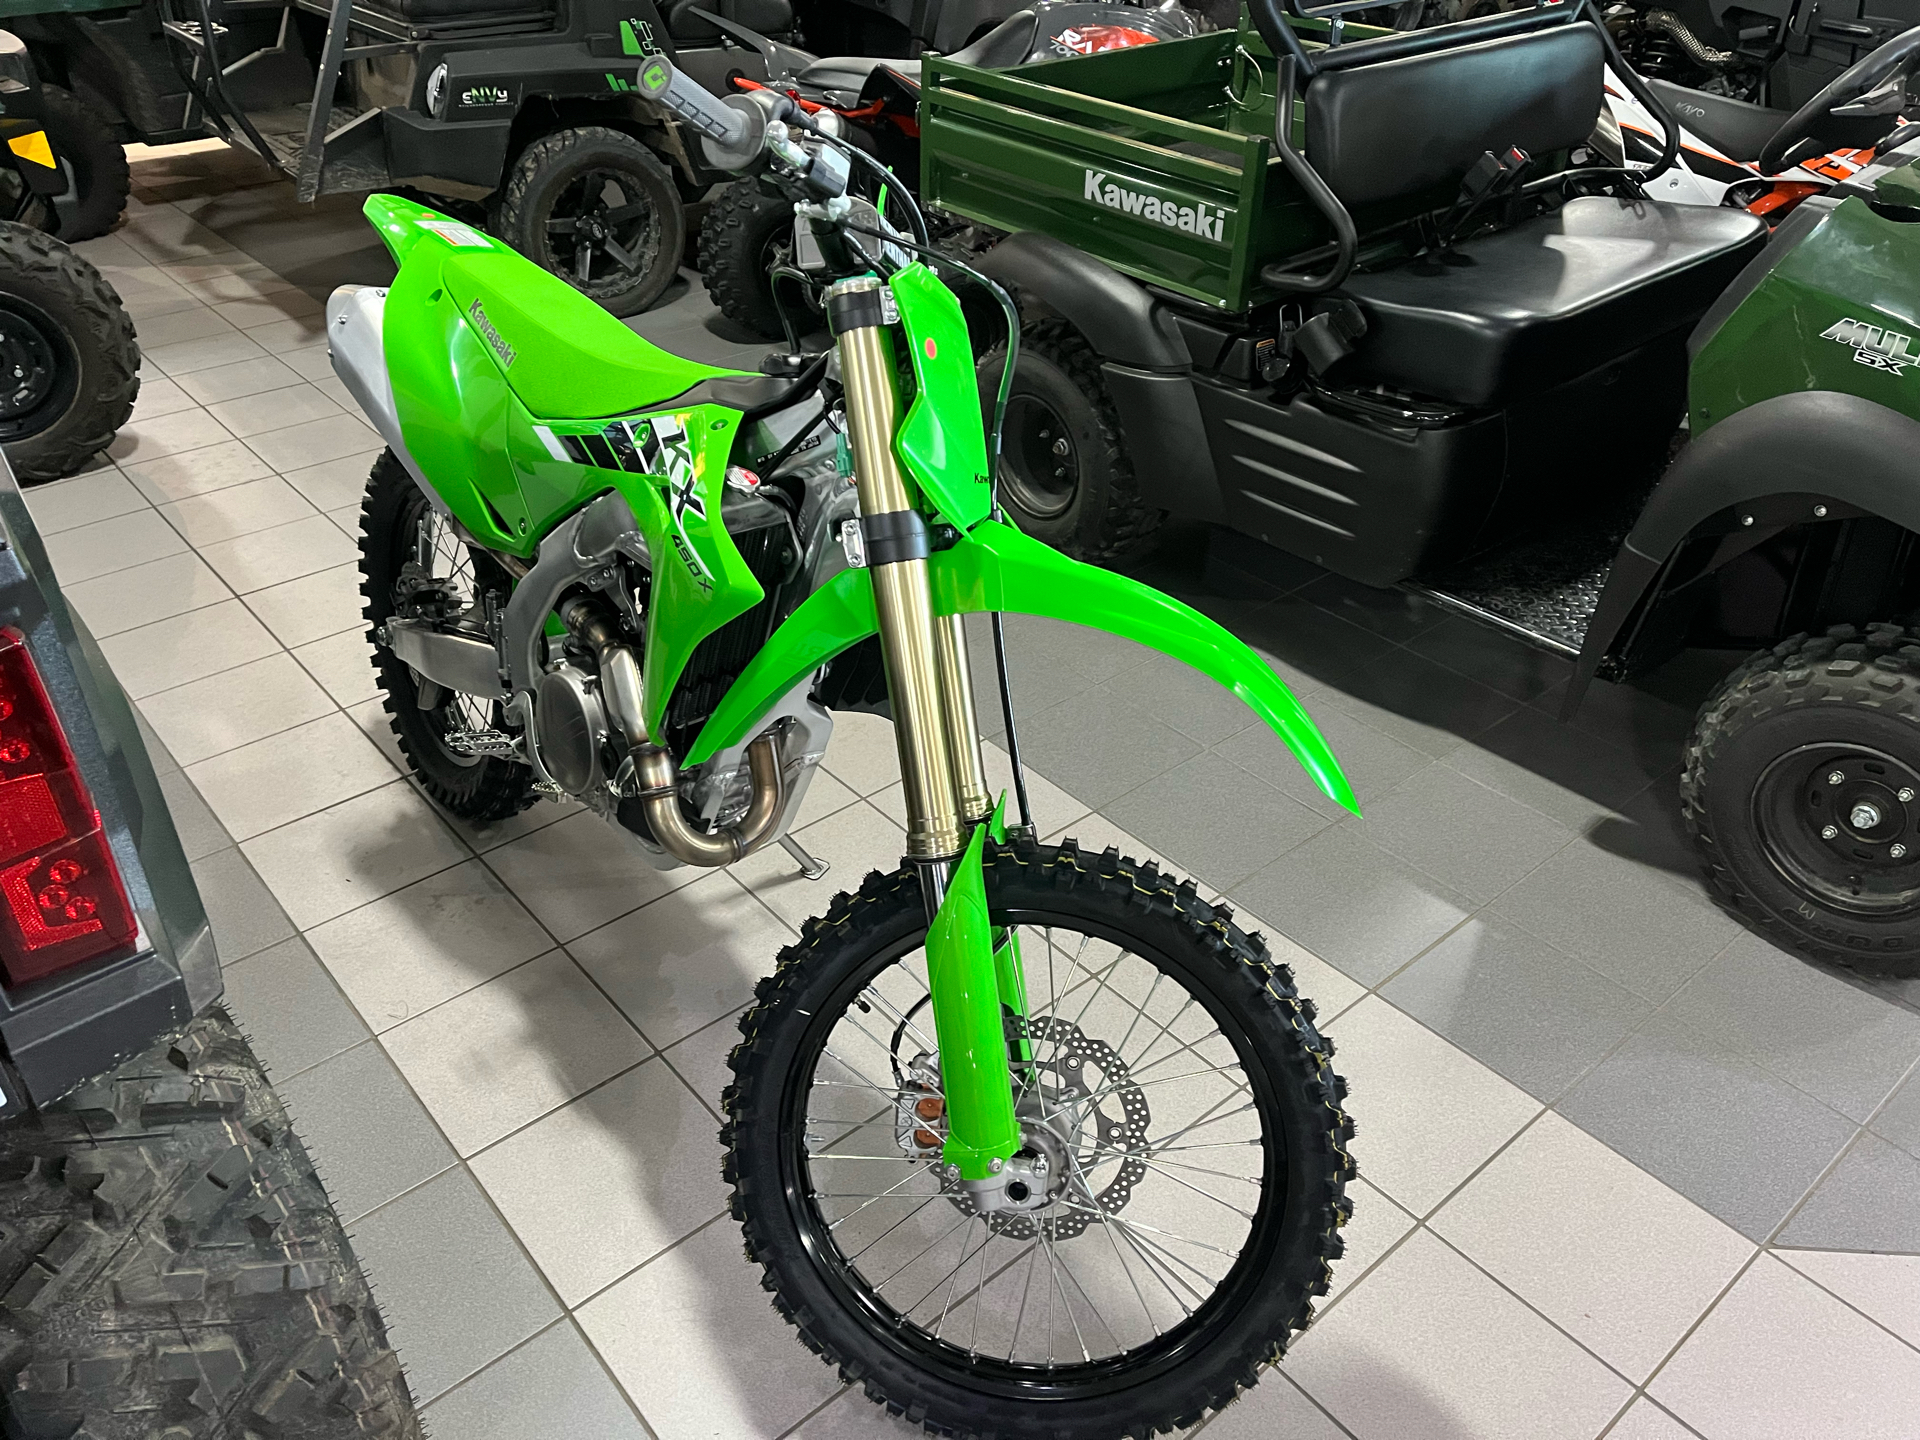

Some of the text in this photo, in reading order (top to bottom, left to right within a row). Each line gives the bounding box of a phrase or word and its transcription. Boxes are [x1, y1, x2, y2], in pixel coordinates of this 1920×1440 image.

[1084, 169, 1226, 242] Kawasaki
[468, 297, 518, 368] Kawasaki
[1819, 317, 1920, 368] MUL
[1853, 349, 1908, 376] SX
[660, 418, 707, 527] KX
